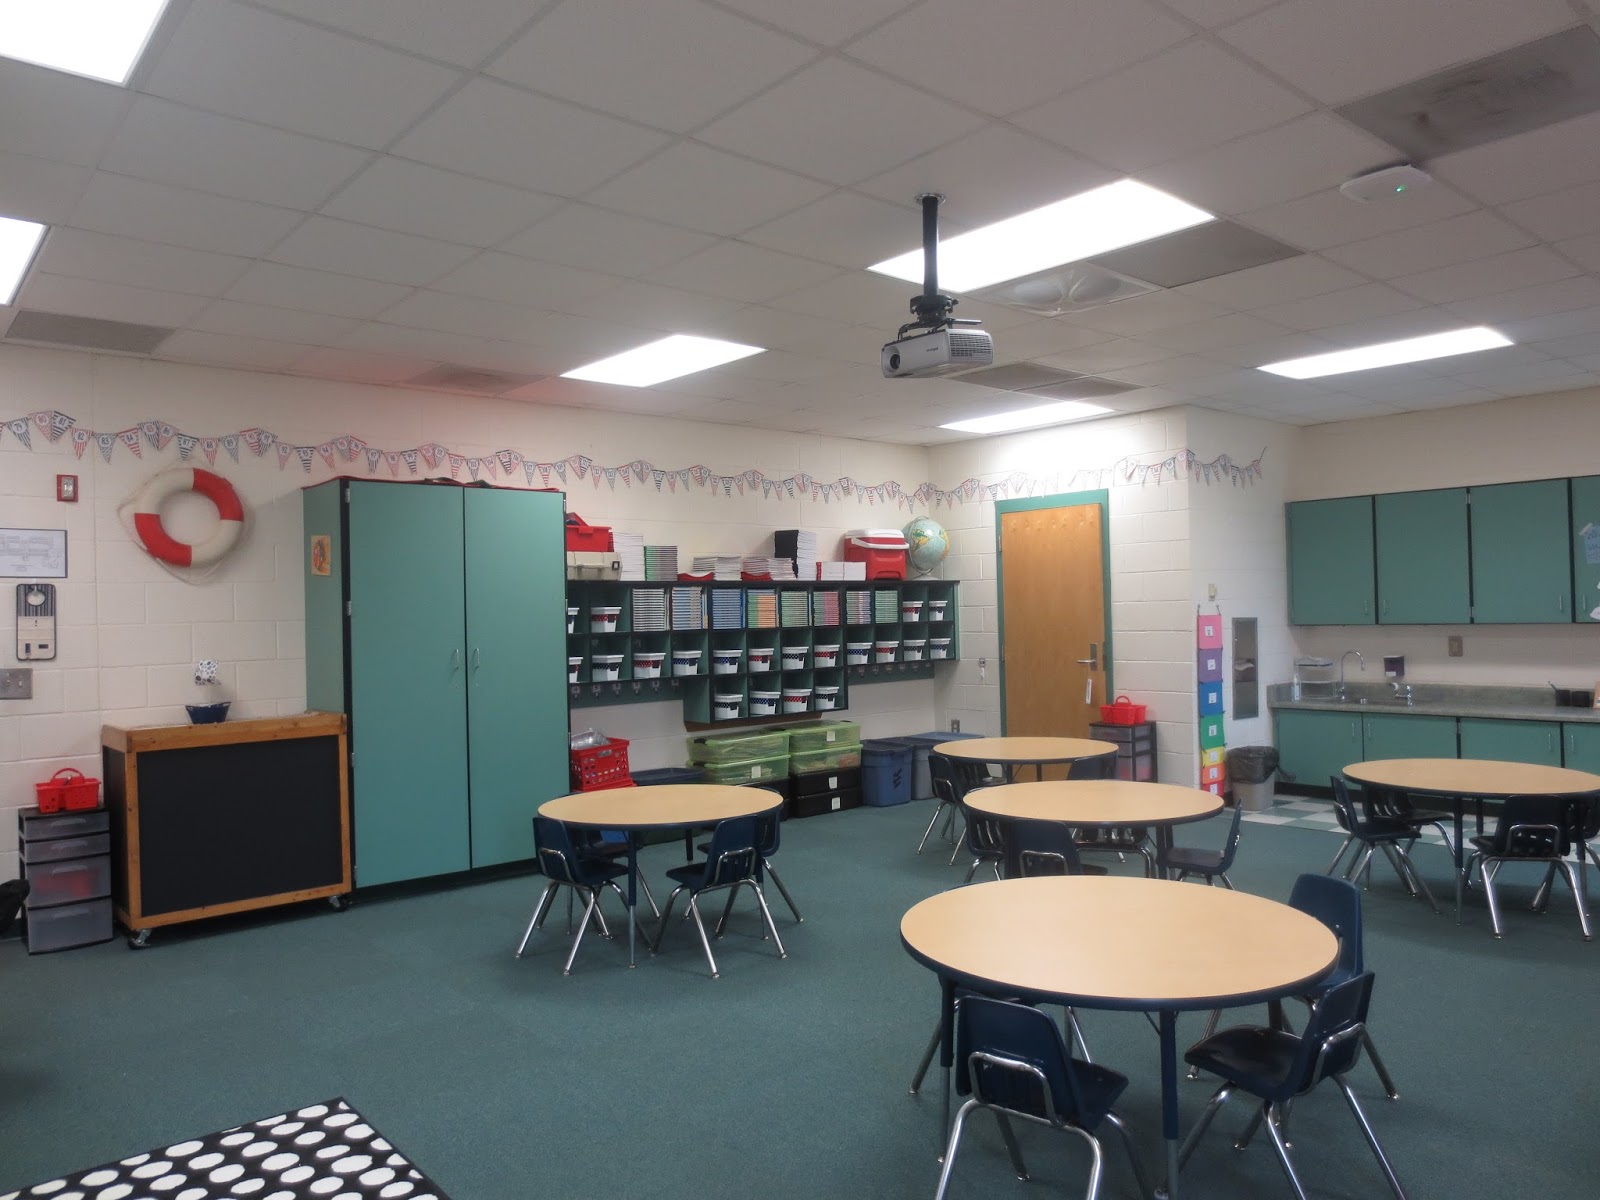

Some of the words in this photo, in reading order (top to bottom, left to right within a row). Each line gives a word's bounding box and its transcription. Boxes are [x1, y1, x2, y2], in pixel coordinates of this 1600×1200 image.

[58, 417, 67, 426] 81
[14, 423, 23, 432] 79
[77, 432, 85, 440] 82
[127, 434, 134, 442] 84
[101, 437, 109, 445] 83
[182, 438, 191, 446] 87
[281, 445, 288, 454] 92
[302, 449, 309, 457] 93
[370, 451, 378, 459] 97
